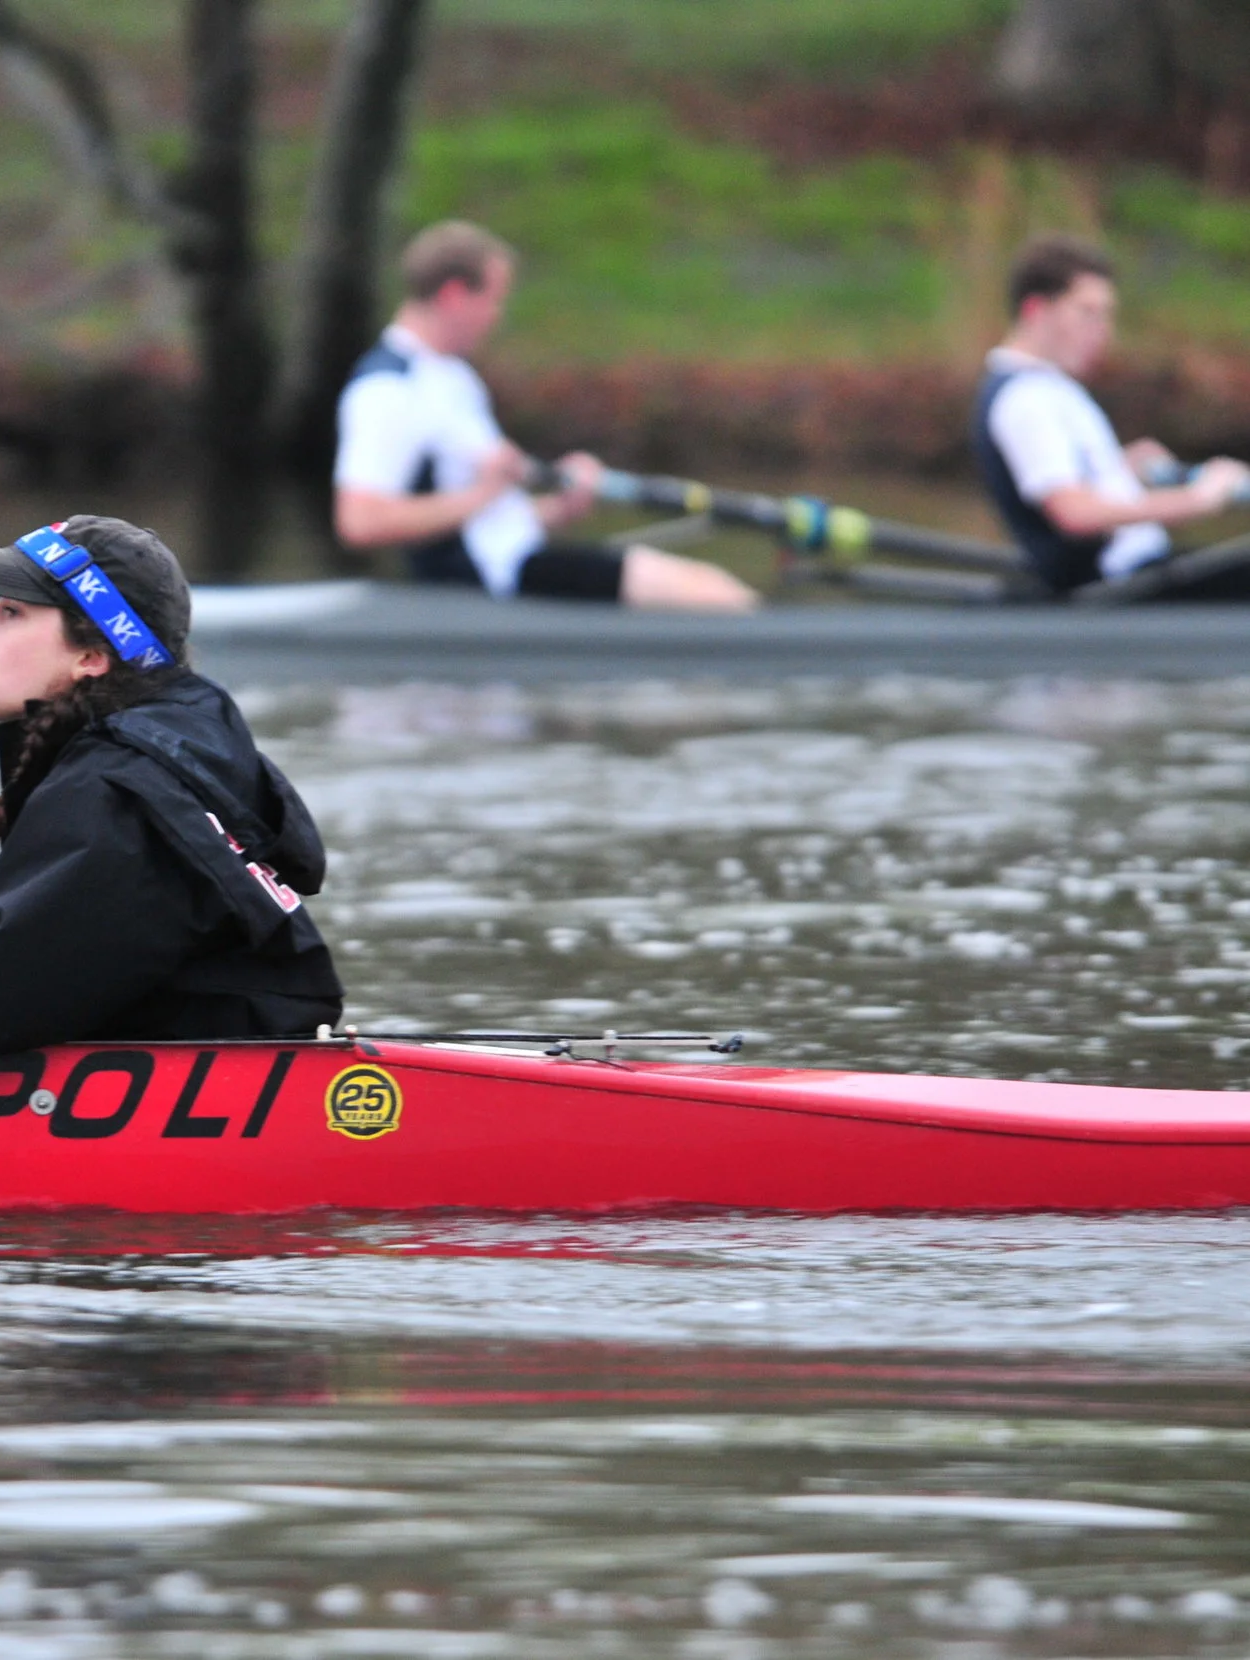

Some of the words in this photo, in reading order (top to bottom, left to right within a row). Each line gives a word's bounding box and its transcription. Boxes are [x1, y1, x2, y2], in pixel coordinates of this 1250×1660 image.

[70, 569, 109, 603] NK
[104, 611, 142, 645] NK
[337, 1083, 388, 1111] 25
